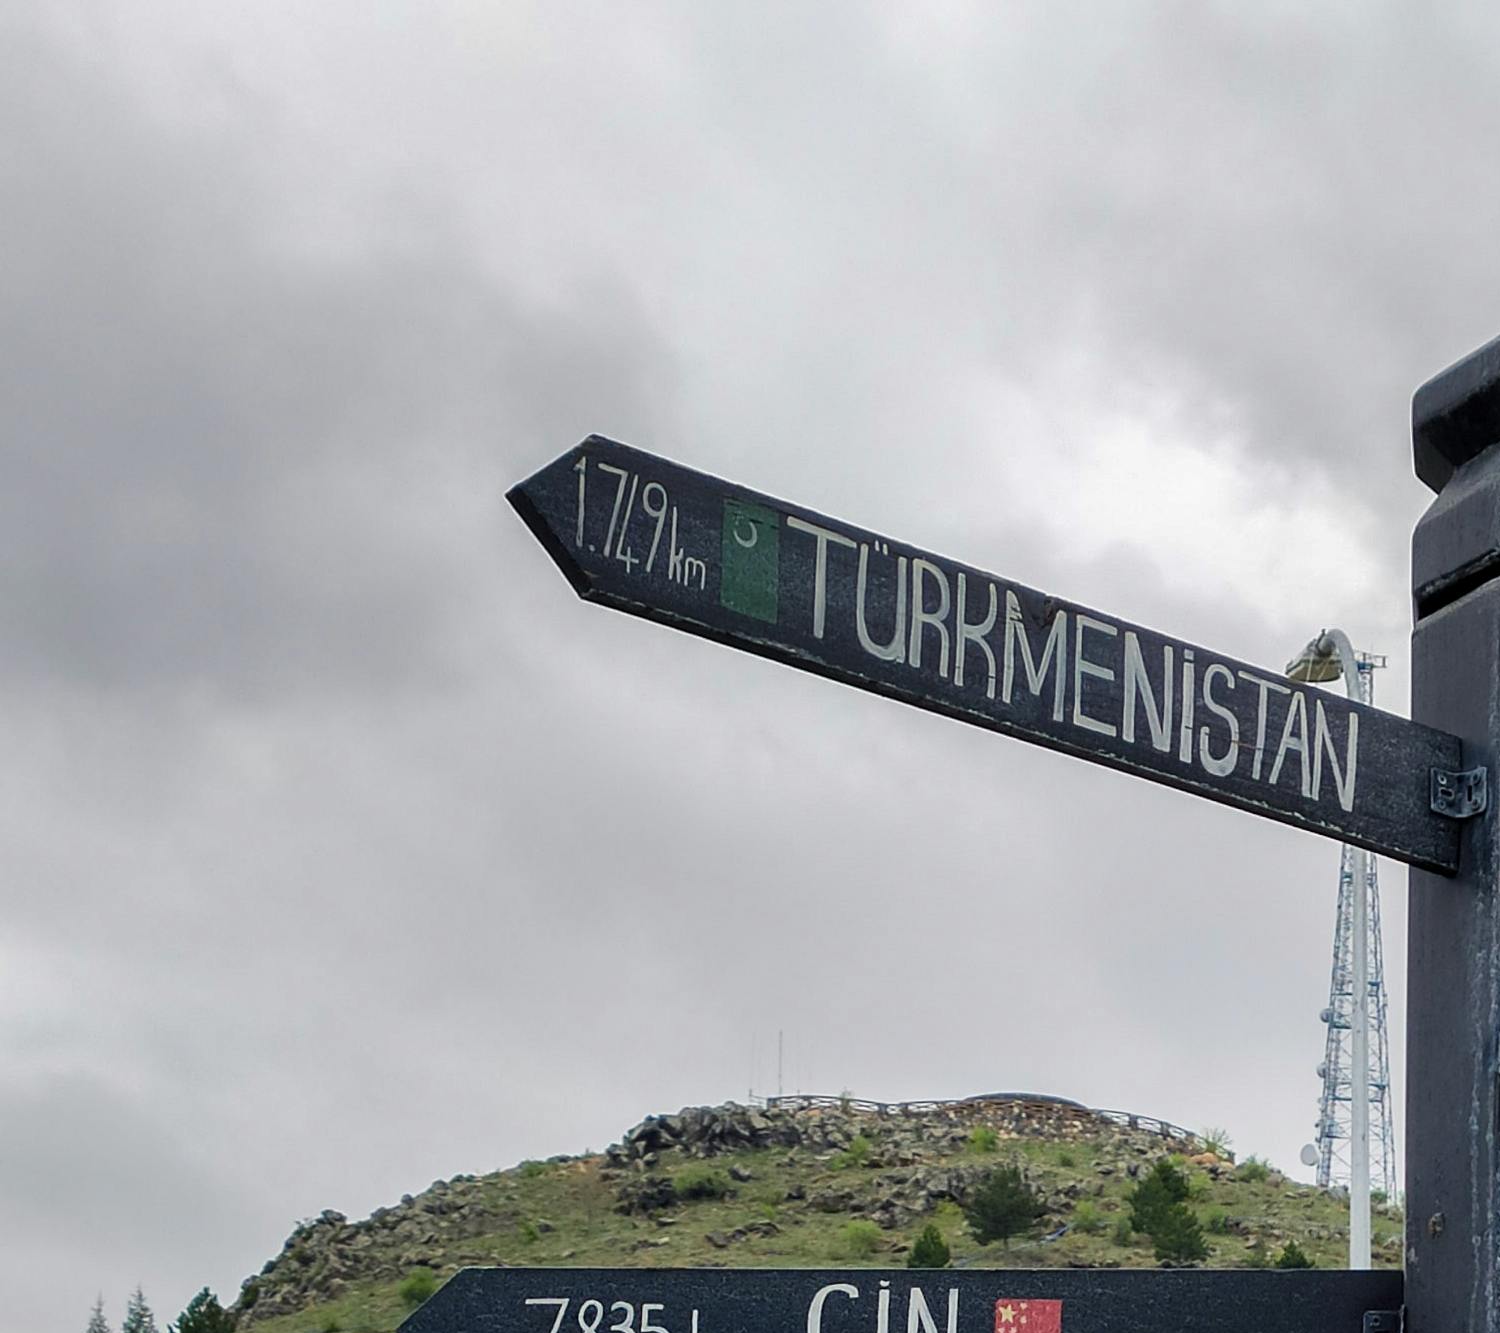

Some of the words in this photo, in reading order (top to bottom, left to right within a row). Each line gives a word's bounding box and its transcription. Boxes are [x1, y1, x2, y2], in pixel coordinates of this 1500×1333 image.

[574, 456, 668, 574] 1.749
[668, 506, 706, 590] km
[786, 514, 1359, 813] TÜRKMENİSTAN
